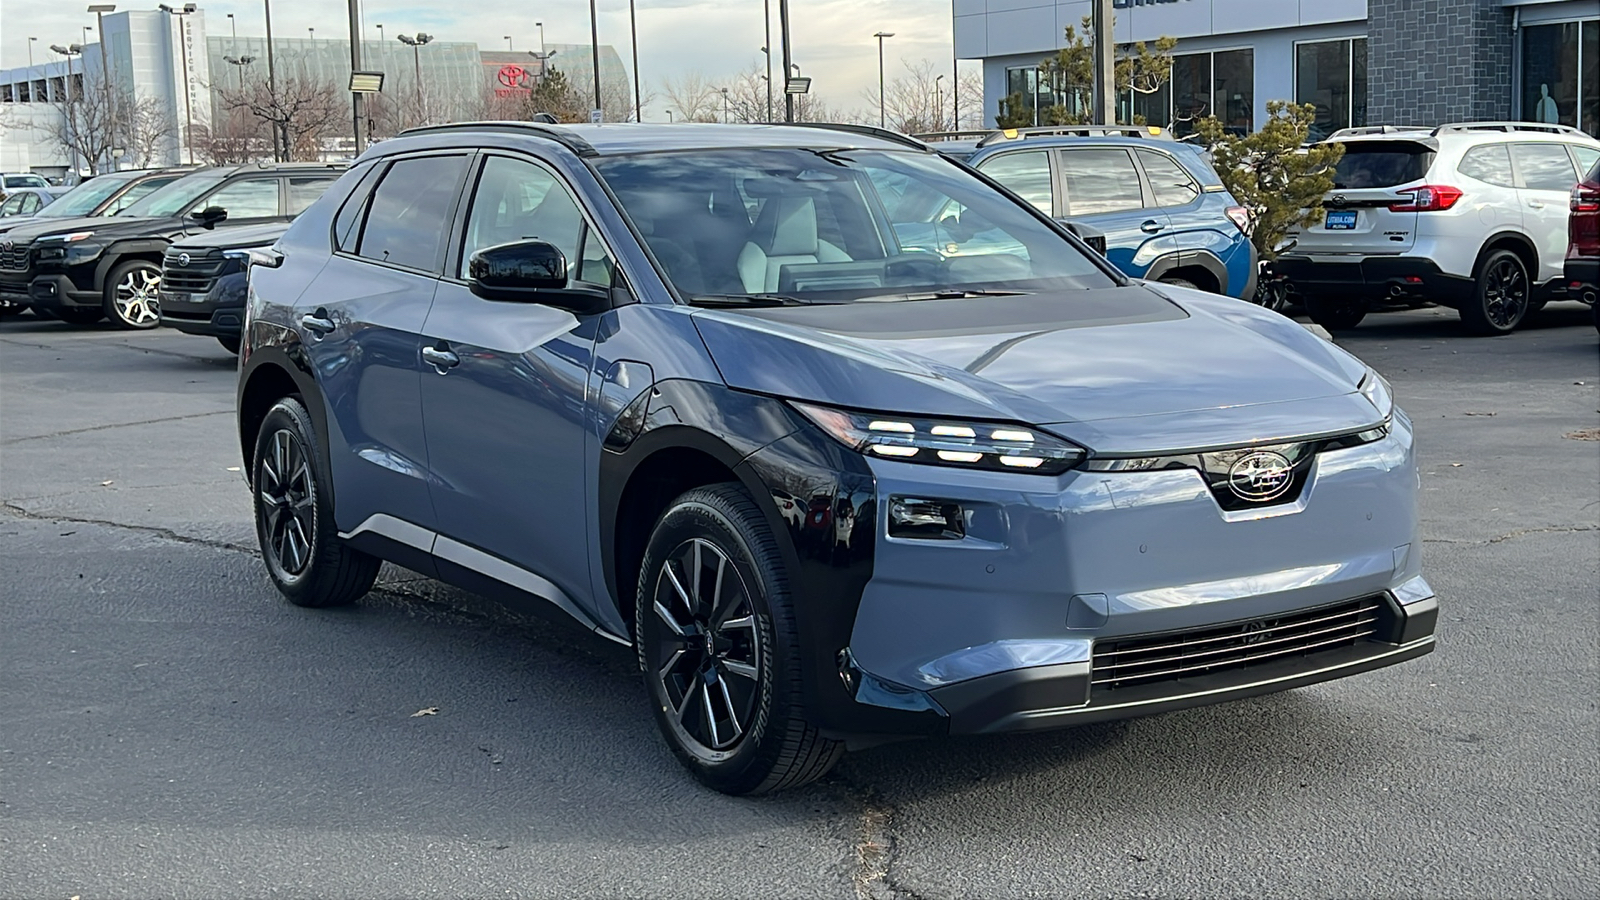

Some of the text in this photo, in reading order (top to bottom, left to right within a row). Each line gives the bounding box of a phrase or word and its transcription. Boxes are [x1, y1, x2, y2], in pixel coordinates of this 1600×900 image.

[186, 21, 198, 120] SERVICE CENTER
[495, 89, 532, 99] TOYOTA
[635, 553, 652, 673] BRIDGESTONE
[753, 613, 773, 748] BRIDGESTONE
